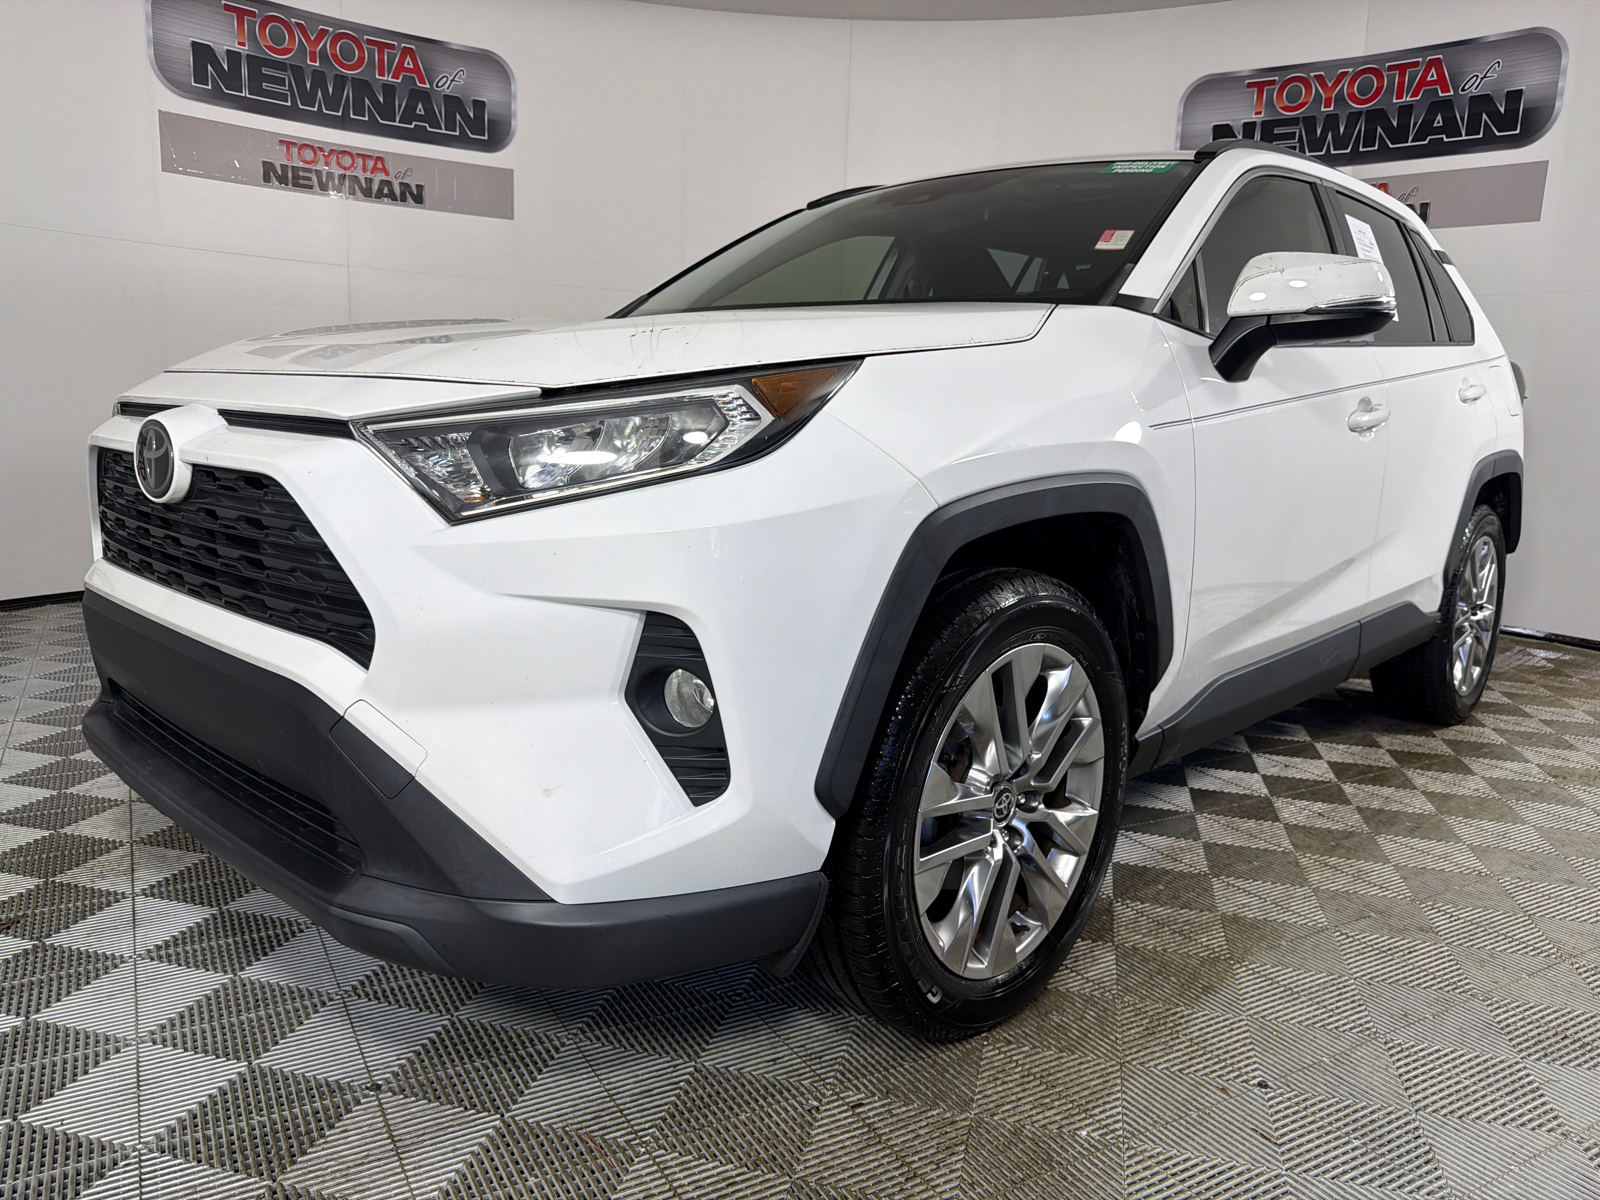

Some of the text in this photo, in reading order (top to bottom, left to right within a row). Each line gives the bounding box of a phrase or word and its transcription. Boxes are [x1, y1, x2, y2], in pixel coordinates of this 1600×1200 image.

[222, 1, 466, 93] TOYOTA of
[190, 38, 489, 140] NEWNAN
[1245, 54, 1502, 118] TOYOTA of
[261, 160, 425, 205] NEWNAN
[278, 139, 413, 180] TOYOTA of
